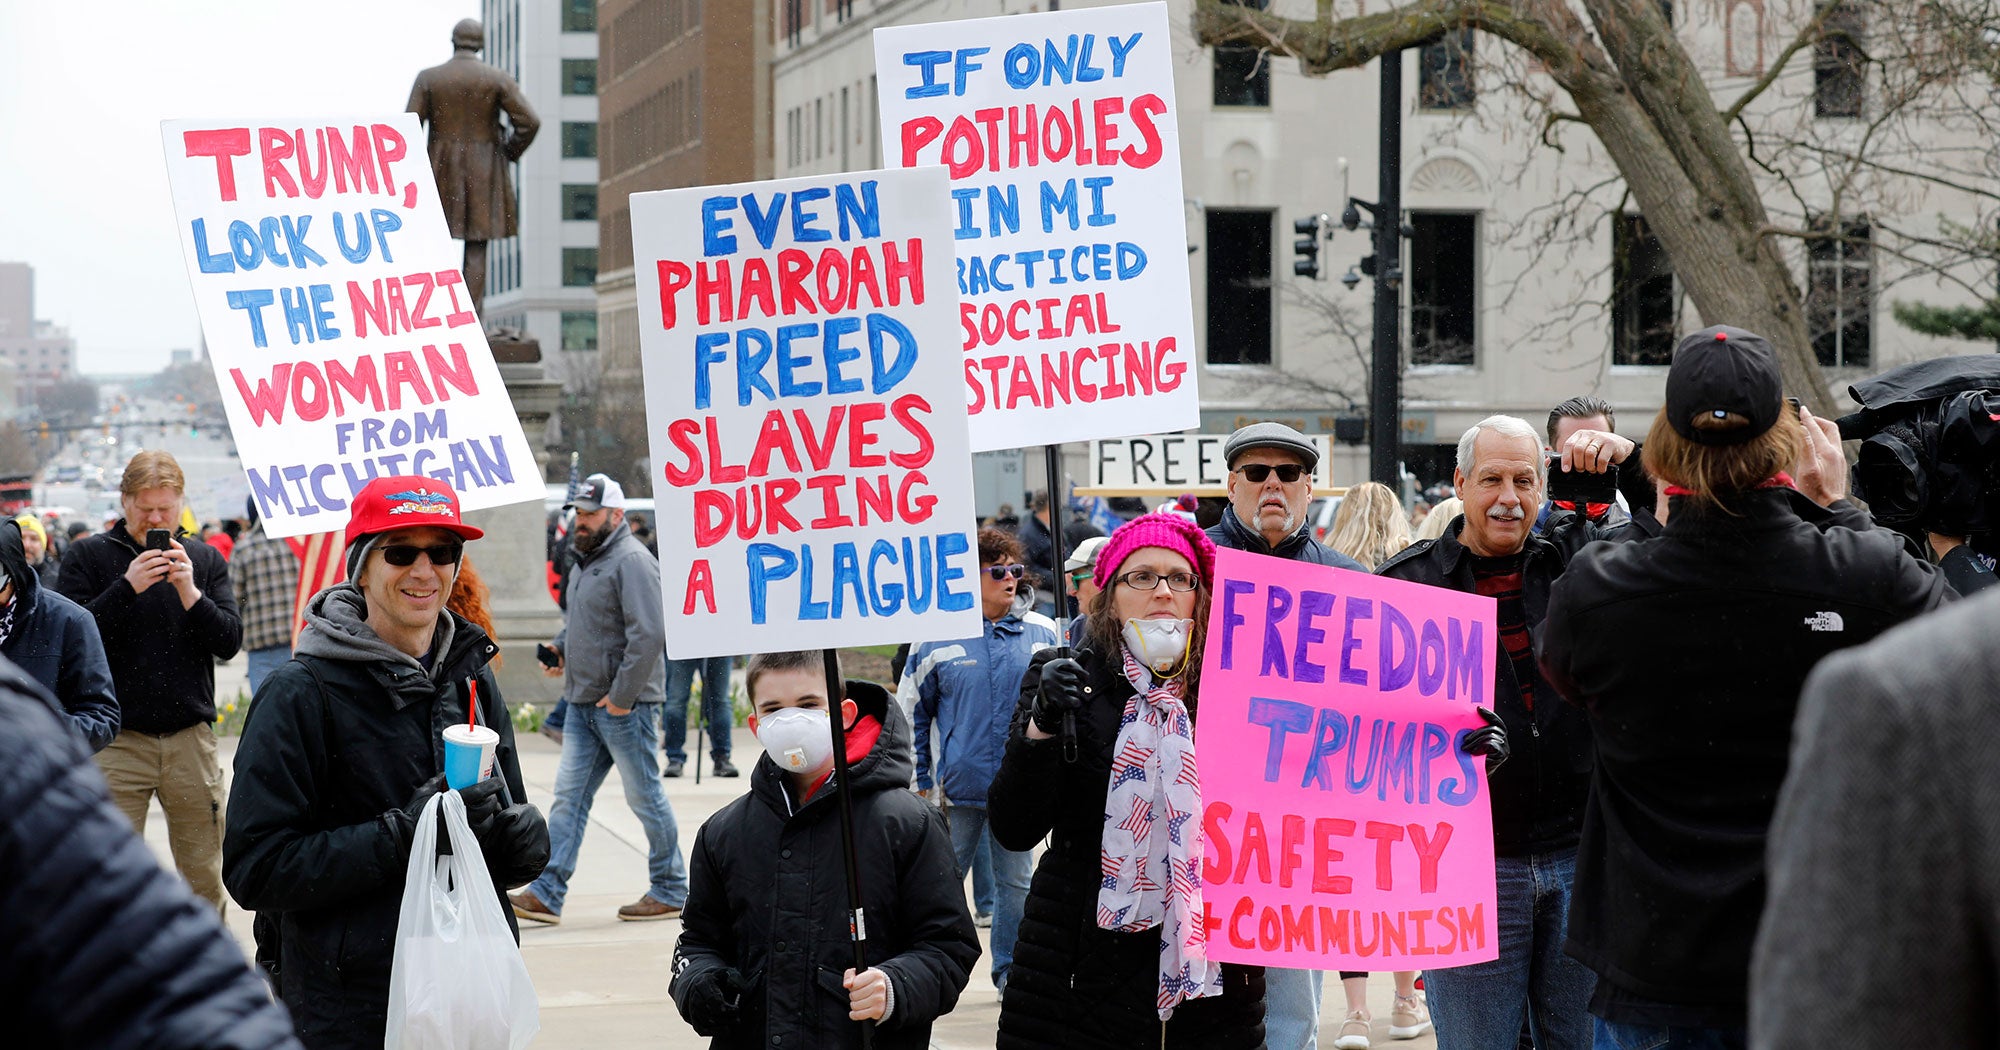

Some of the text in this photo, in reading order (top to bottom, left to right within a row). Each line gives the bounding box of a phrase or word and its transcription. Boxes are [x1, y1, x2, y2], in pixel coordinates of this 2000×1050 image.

[902, 32, 1143, 99] IF ONLY
[184, 124, 418, 208] TRUMP,
[901, 93, 1167, 180] POTHOLES
[191, 208, 402, 273] LOCK UP
[702, 180, 881, 257] EVEN
[951, 176, 1116, 240] IN MI
[657, 238, 925, 330] PHAROAH
[957, 241, 1147, 296] RACTICED
[226, 269, 475, 348] THE NAZI
[960, 292, 1121, 351] SOCIAL
[230, 343, 479, 428] WOMAN
[695, 312, 919, 410] FREED
[964, 336, 1187, 415] STANCING
[335, 409, 448, 455] FROM
[664, 394, 935, 487] SLAVES
[694, 470, 939, 548] DURING
[682, 532, 975, 624] A PLAGUE
[1220, 578, 1483, 704] FREEDOM
[1804, 617, 1829, 625] NORTH
[1247, 696, 1478, 807] TRUMPS
[1203, 801, 1454, 894] SAFETY
